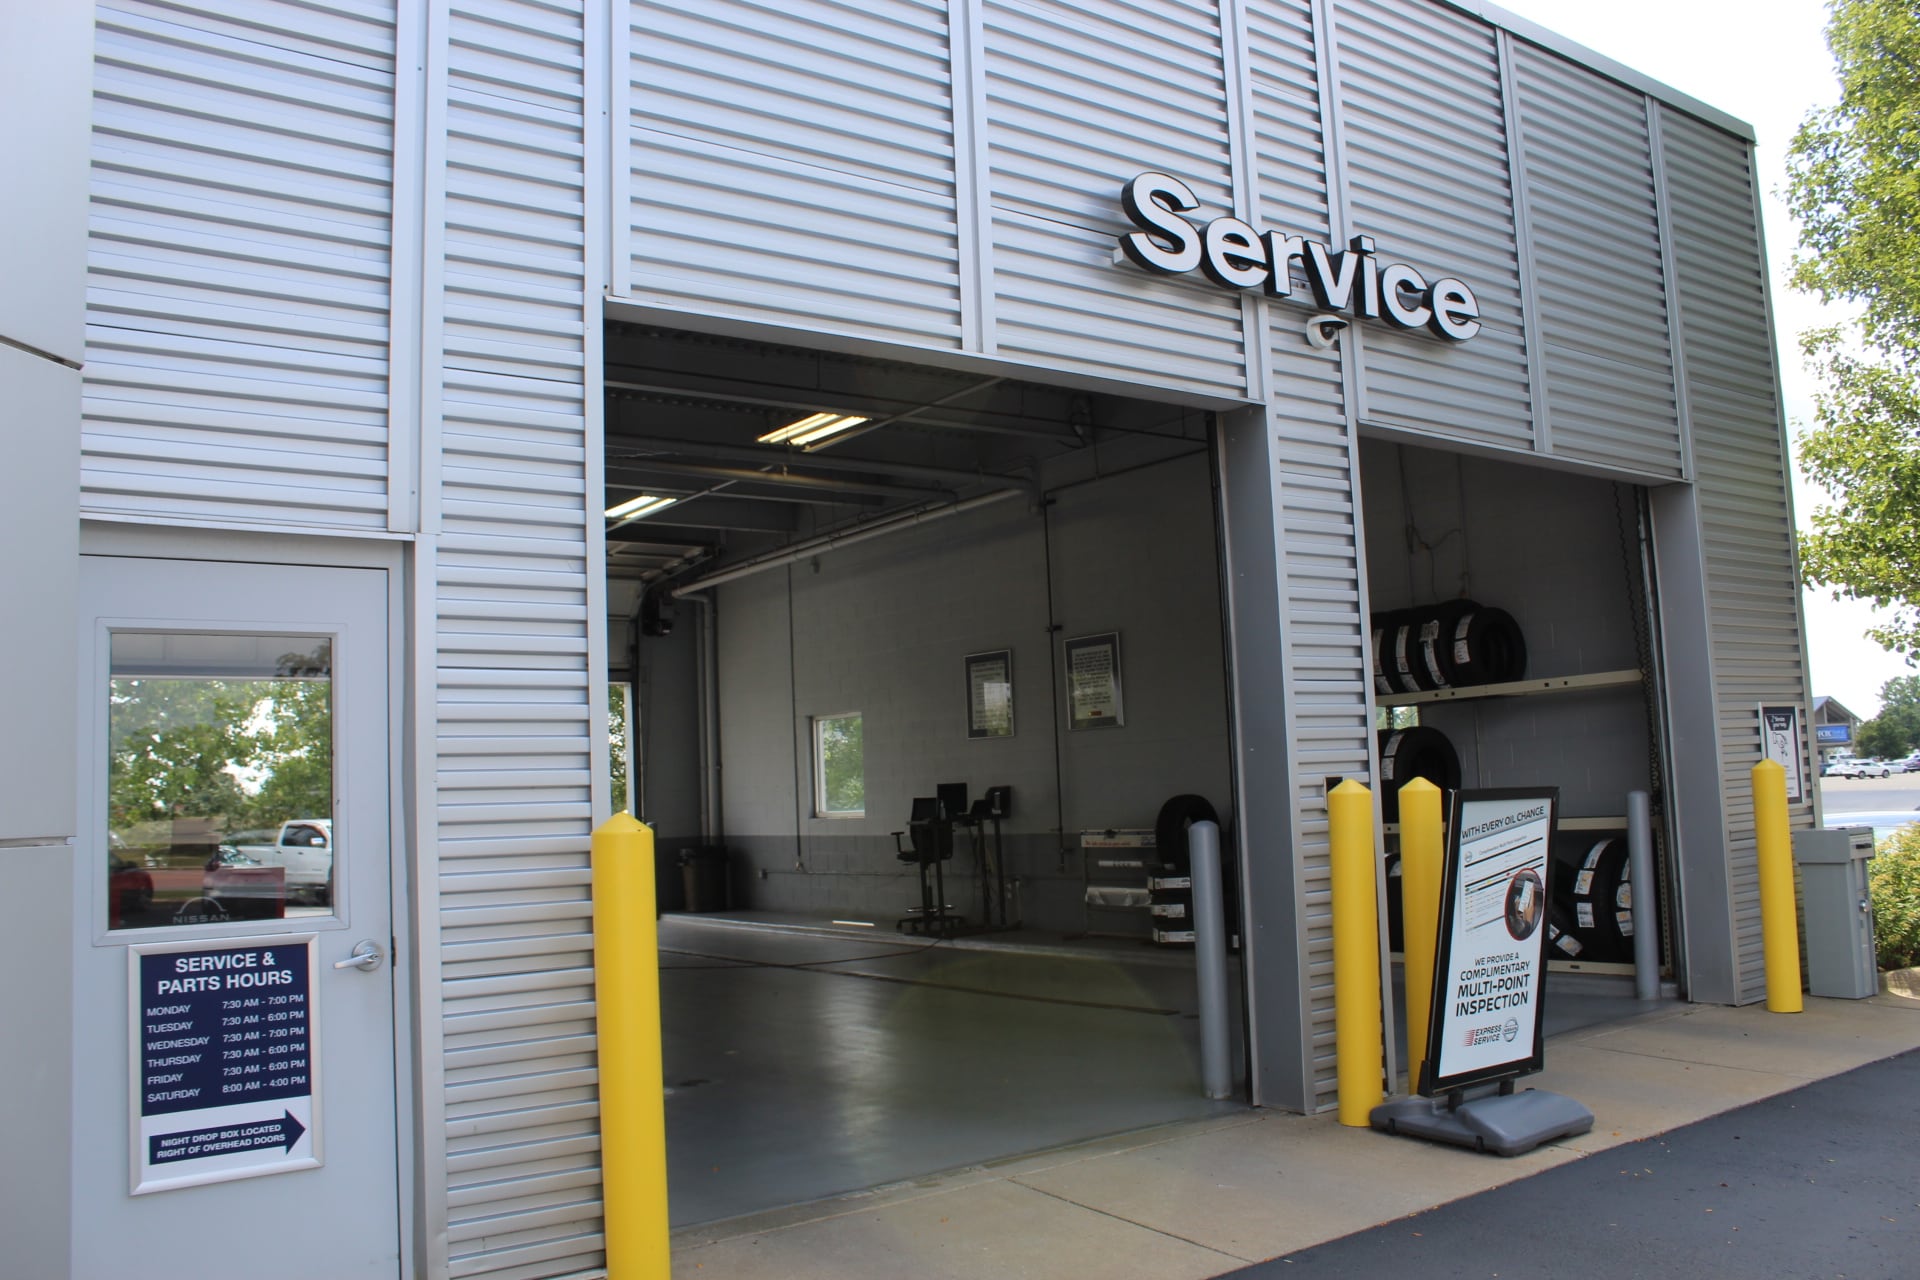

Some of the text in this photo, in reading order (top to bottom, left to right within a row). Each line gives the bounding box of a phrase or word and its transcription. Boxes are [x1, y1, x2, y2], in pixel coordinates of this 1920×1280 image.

[1118, 171, 1482, 343] Service
[1461, 806, 1544, 839] WITH EVERY OIL CHANGE
[172, 914, 230, 924] NISSAN
[175, 952, 275, 973] SERVICE &
[1475, 957, 1486, 966] WE
[1487, 952, 1514, 964] PROVIDE
[157, 970, 293, 995] PARTS HOURS
[1460, 961, 1530, 981] COMPLIMENTARY
[1458, 974, 1530, 999] MULTI-POINT
[147, 1005, 191, 1016] MONDAY
[222, 1000, 241, 1009] 7:30
[243, 998, 259, 1007] AM
[268, 996, 287, 1005] 7:00
[289, 994, 304, 1003] PM
[1456, 991, 1528, 1016] INSPECTION
[147, 1021, 193, 1033] TUESDAY
[222, 1017, 241, 1026] 7:30
[243, 1014, 259, 1024] AM
[268, 1012, 287, 1021] 6:00
[289, 1011, 304, 1020] PM
[1475, 1024, 1502, 1036] EXPRESS
[147, 1036, 210, 1050] WEDNESDAY
[223, 1033, 242, 1042] 7:30
[243, 1031, 259, 1040] AM
[268, 1029, 288, 1038] 7:00
[289, 1027, 304, 1036] PM
[1473, 1033, 1500, 1046] SERVICE
[147, 1054, 202, 1067] THURSDAY
[222, 1050, 241, 1059] 7:30
[243, 1048, 259, 1057] AM
[268, 1045, 288, 1054] 6:00
[290, 1043, 305, 1052] PM
[147, 1073, 184, 1085] FRIDAY
[223, 1067, 242, 1076] 7:30
[243, 1064, 260, 1074] AM
[268, 1061, 288, 1071] 6:00
[290, 1060, 305, 1068] PM
[147, 1088, 201, 1102] SATURDAY
[222, 1084, 242, 1093] 8:00
[244, 1081, 260, 1090] AM
[269, 1078, 289, 1087] 4:00
[291, 1076, 306, 1085] PM
[156, 1134, 286, 1159] RIGHT OF OVERHEAD DOORS
[161, 1124, 282, 1147] NIGHT DROP BOX LOCATED
